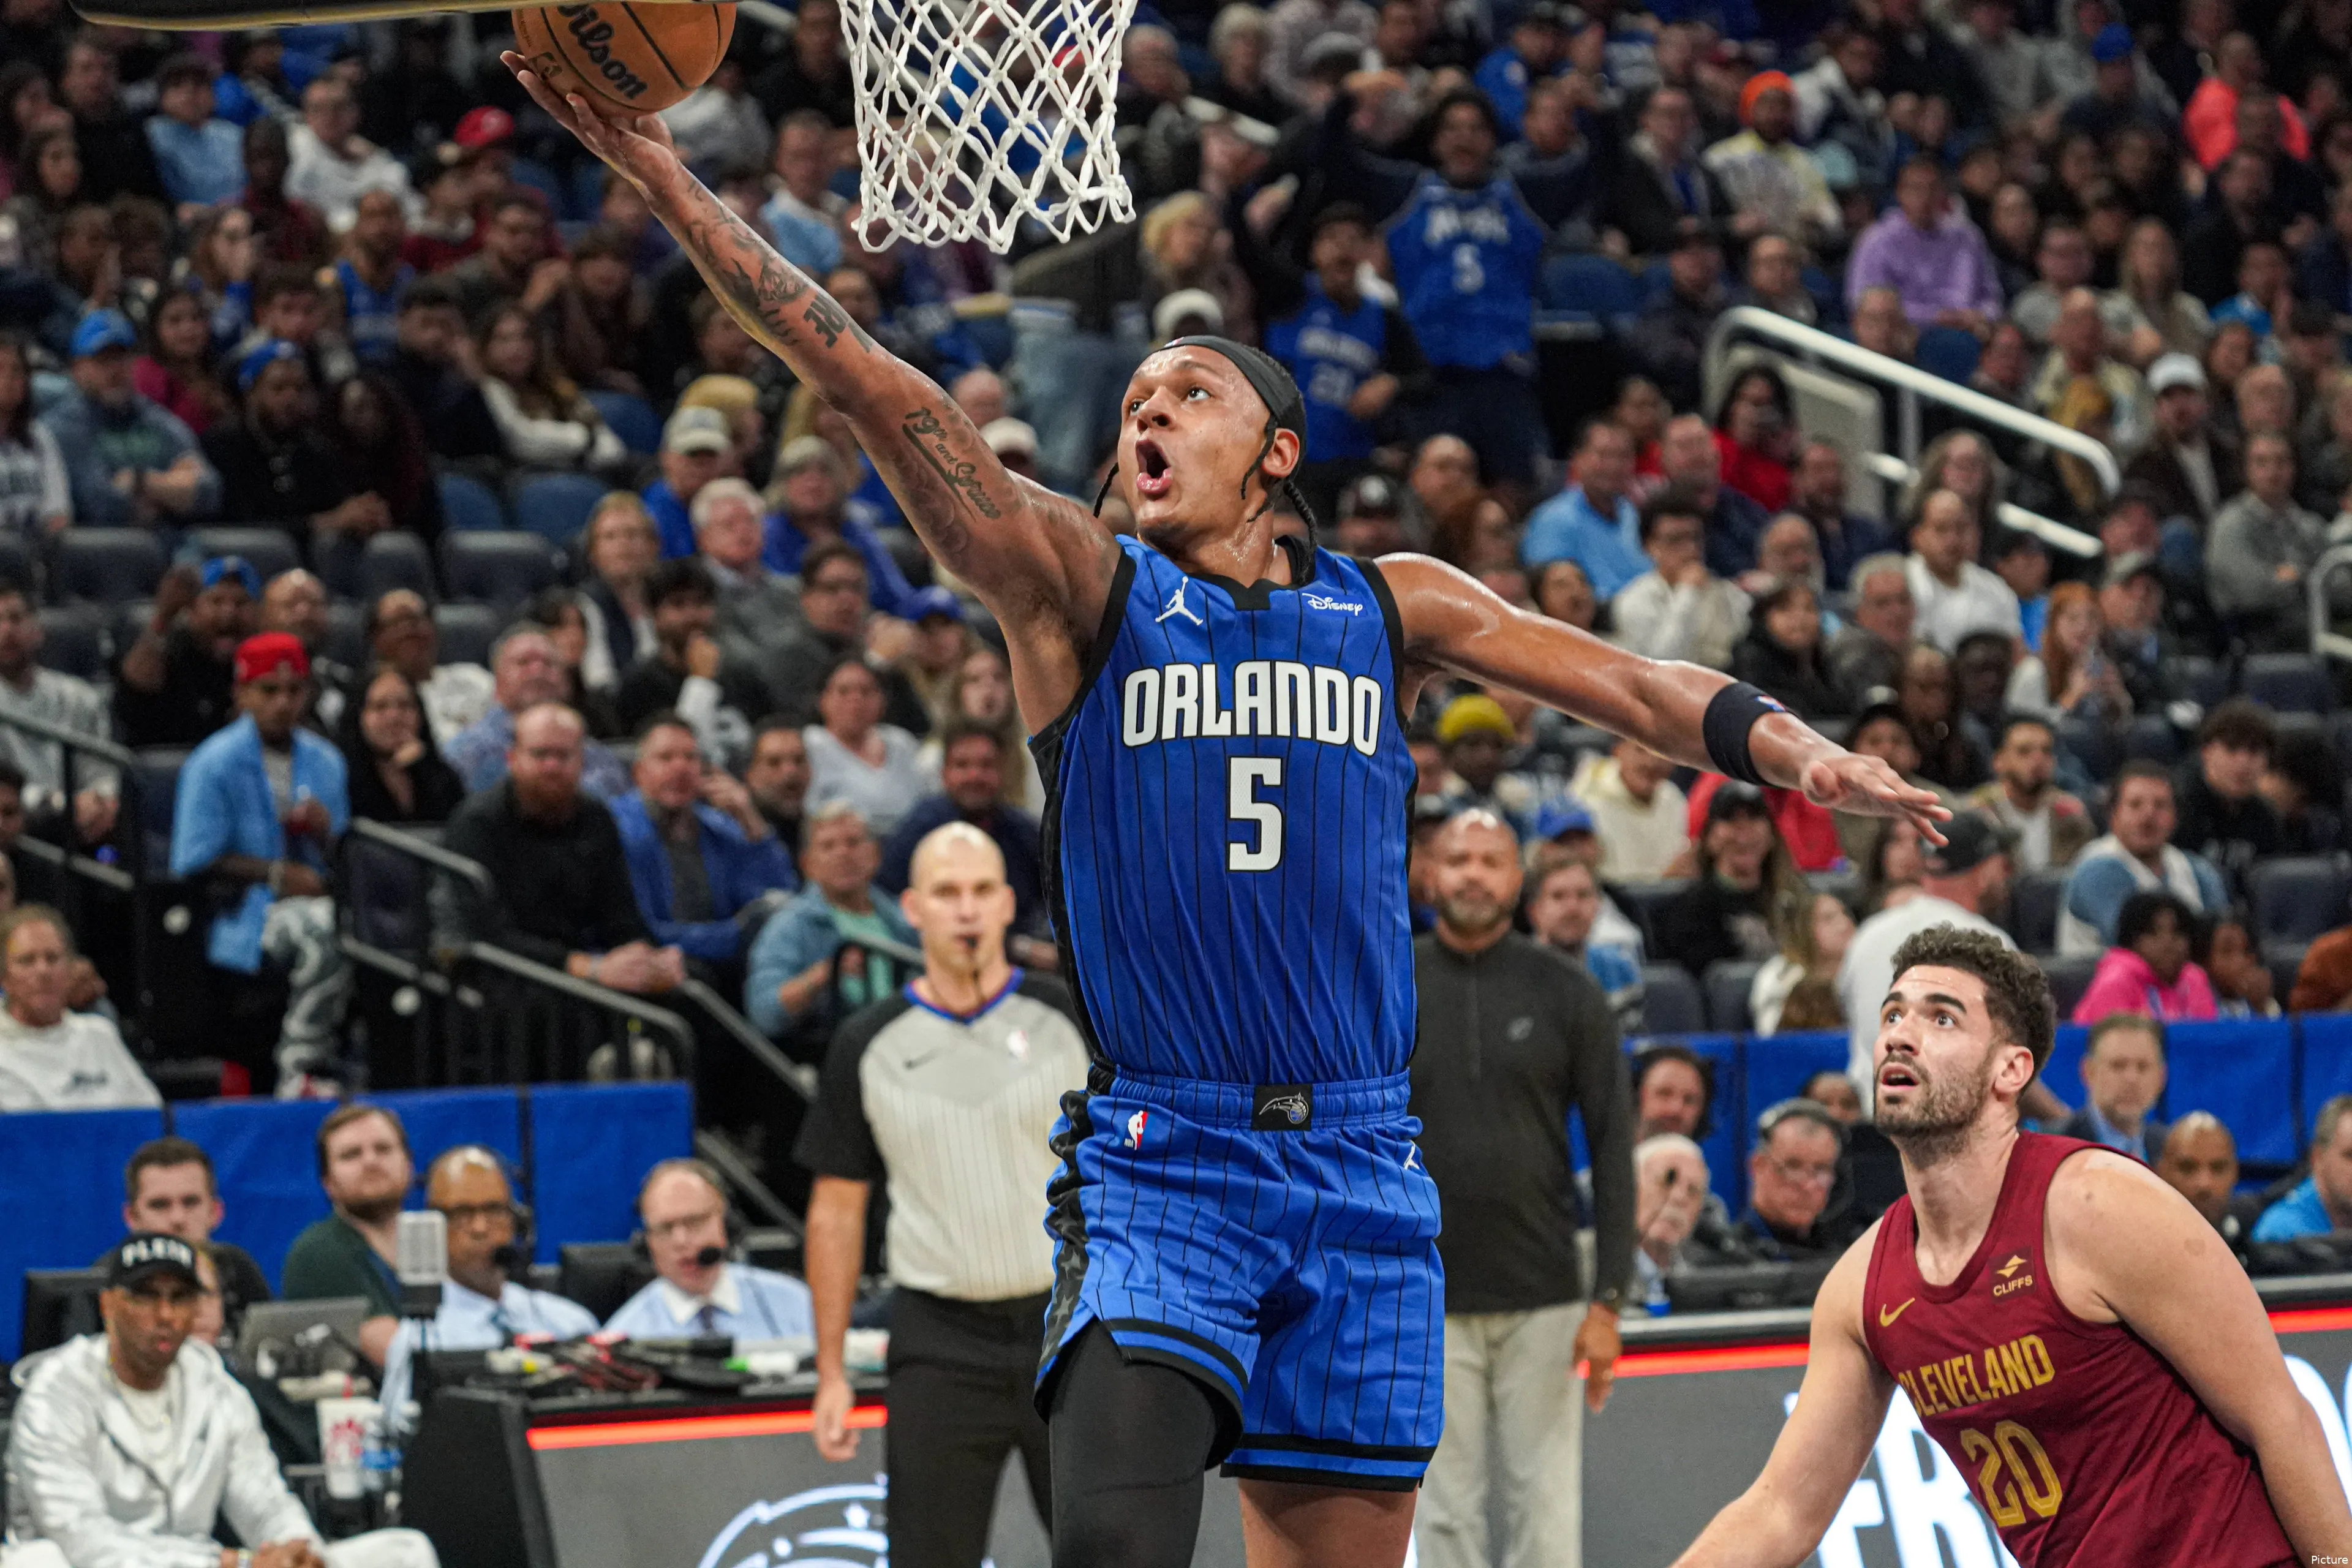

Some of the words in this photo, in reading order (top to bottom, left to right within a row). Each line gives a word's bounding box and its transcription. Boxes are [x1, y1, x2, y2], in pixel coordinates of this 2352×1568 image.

[557, 4, 647, 99] ilson
[1302, 592, 1363, 616] Disney
[1122, 660, 1382, 756] ORLANDO
[1229, 756, 1283, 870] 5
[1993, 1275, 2033, 1297] CLIFFS
[1898, 1334, 2056, 1418] CLEVELAND
[1960, 1419, 2063, 1528] 20
